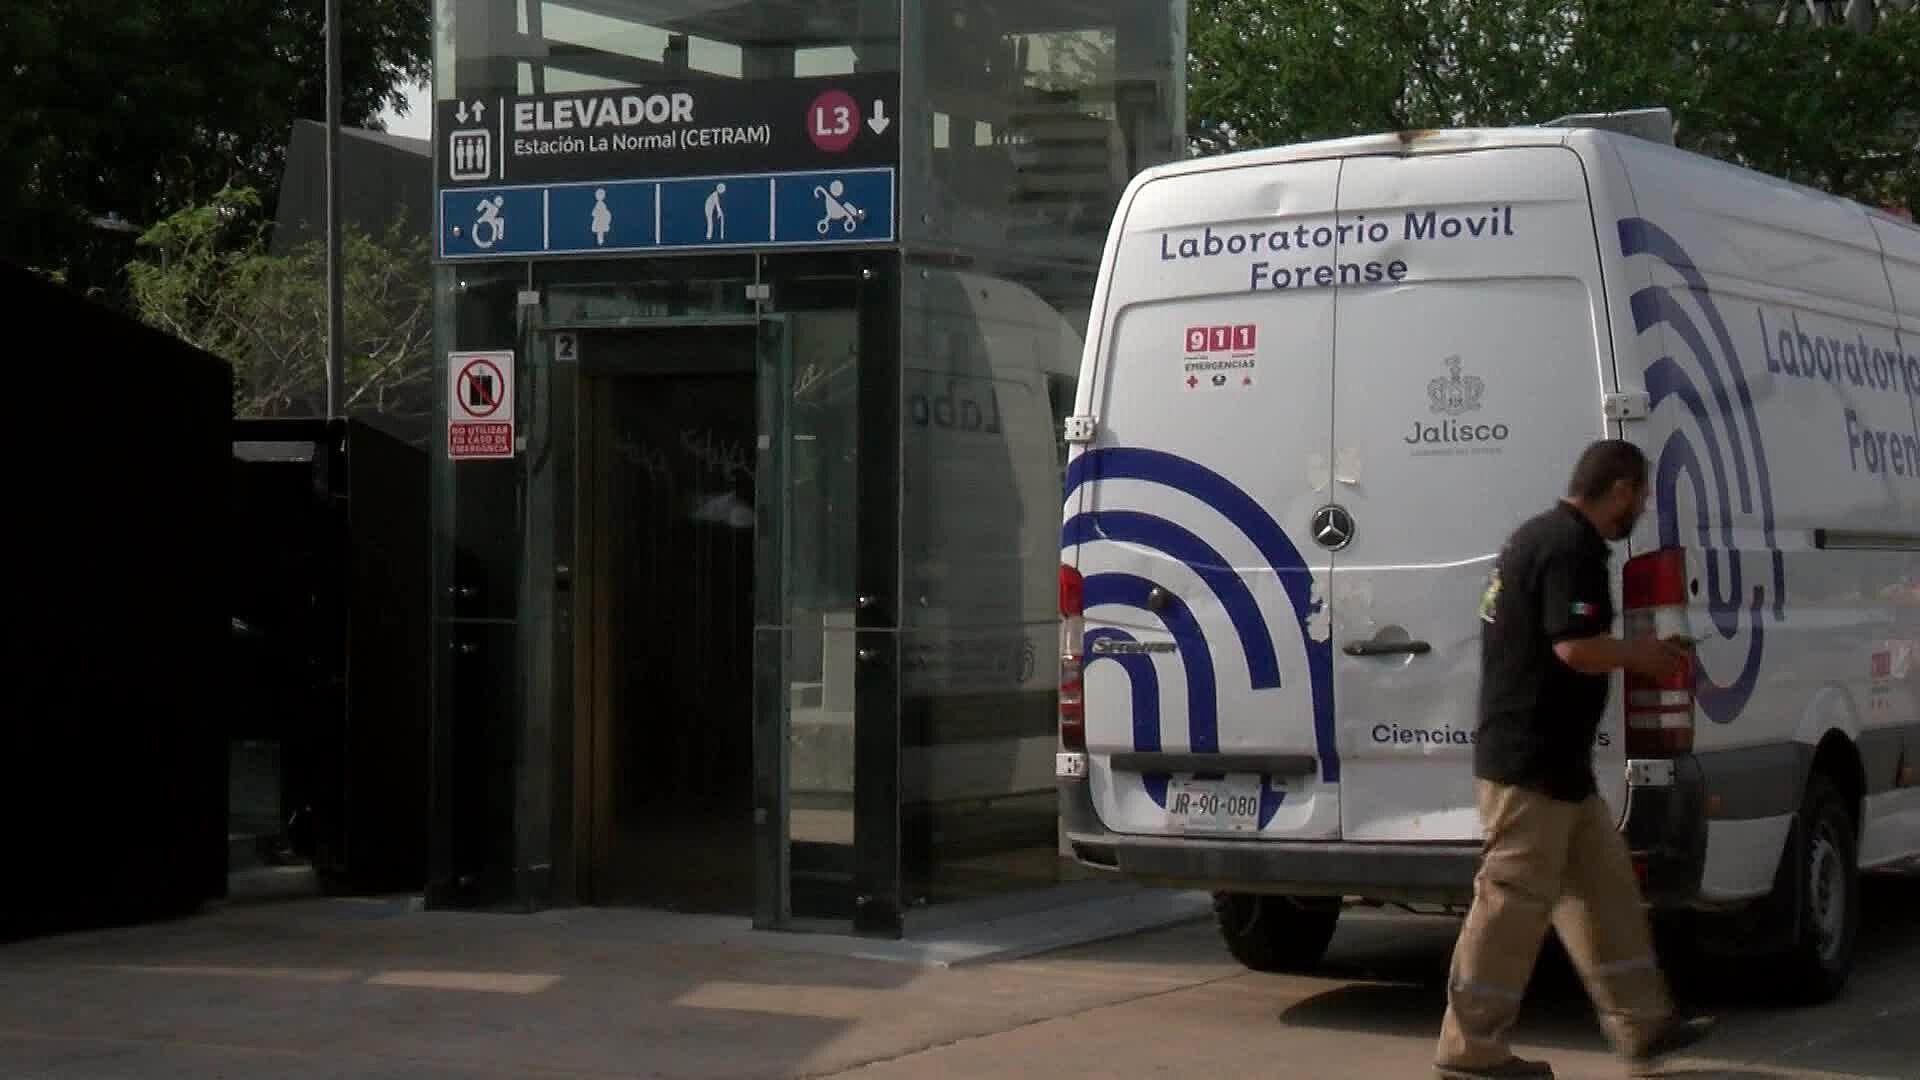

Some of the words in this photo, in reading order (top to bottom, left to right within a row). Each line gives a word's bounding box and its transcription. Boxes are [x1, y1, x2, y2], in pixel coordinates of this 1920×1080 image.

[514, 93, 694, 132] ELEVADOR
[816, 107, 850, 136] L3
[514, 136, 585, 156] Estación
[588, 134, 609, 152] La
[612, 130, 677, 151] Normal
[680, 124, 771, 150] (CETRAM)
[1161, 214, 1389, 261] Laboratorio
[1404, 205, 1515, 242] Movil
[1250, 259, 1409, 290] Forense
[559, 335, 575, 357] 2
[1190, 327, 1249, 350] 911
[1184, 359, 1256, 372] EMERGENCIAS
[1405, 419, 1509, 444] Jalisco
[1371, 723, 1481, 746] Ciencias
[1170, 792, 1257, 817] JR-90-080
